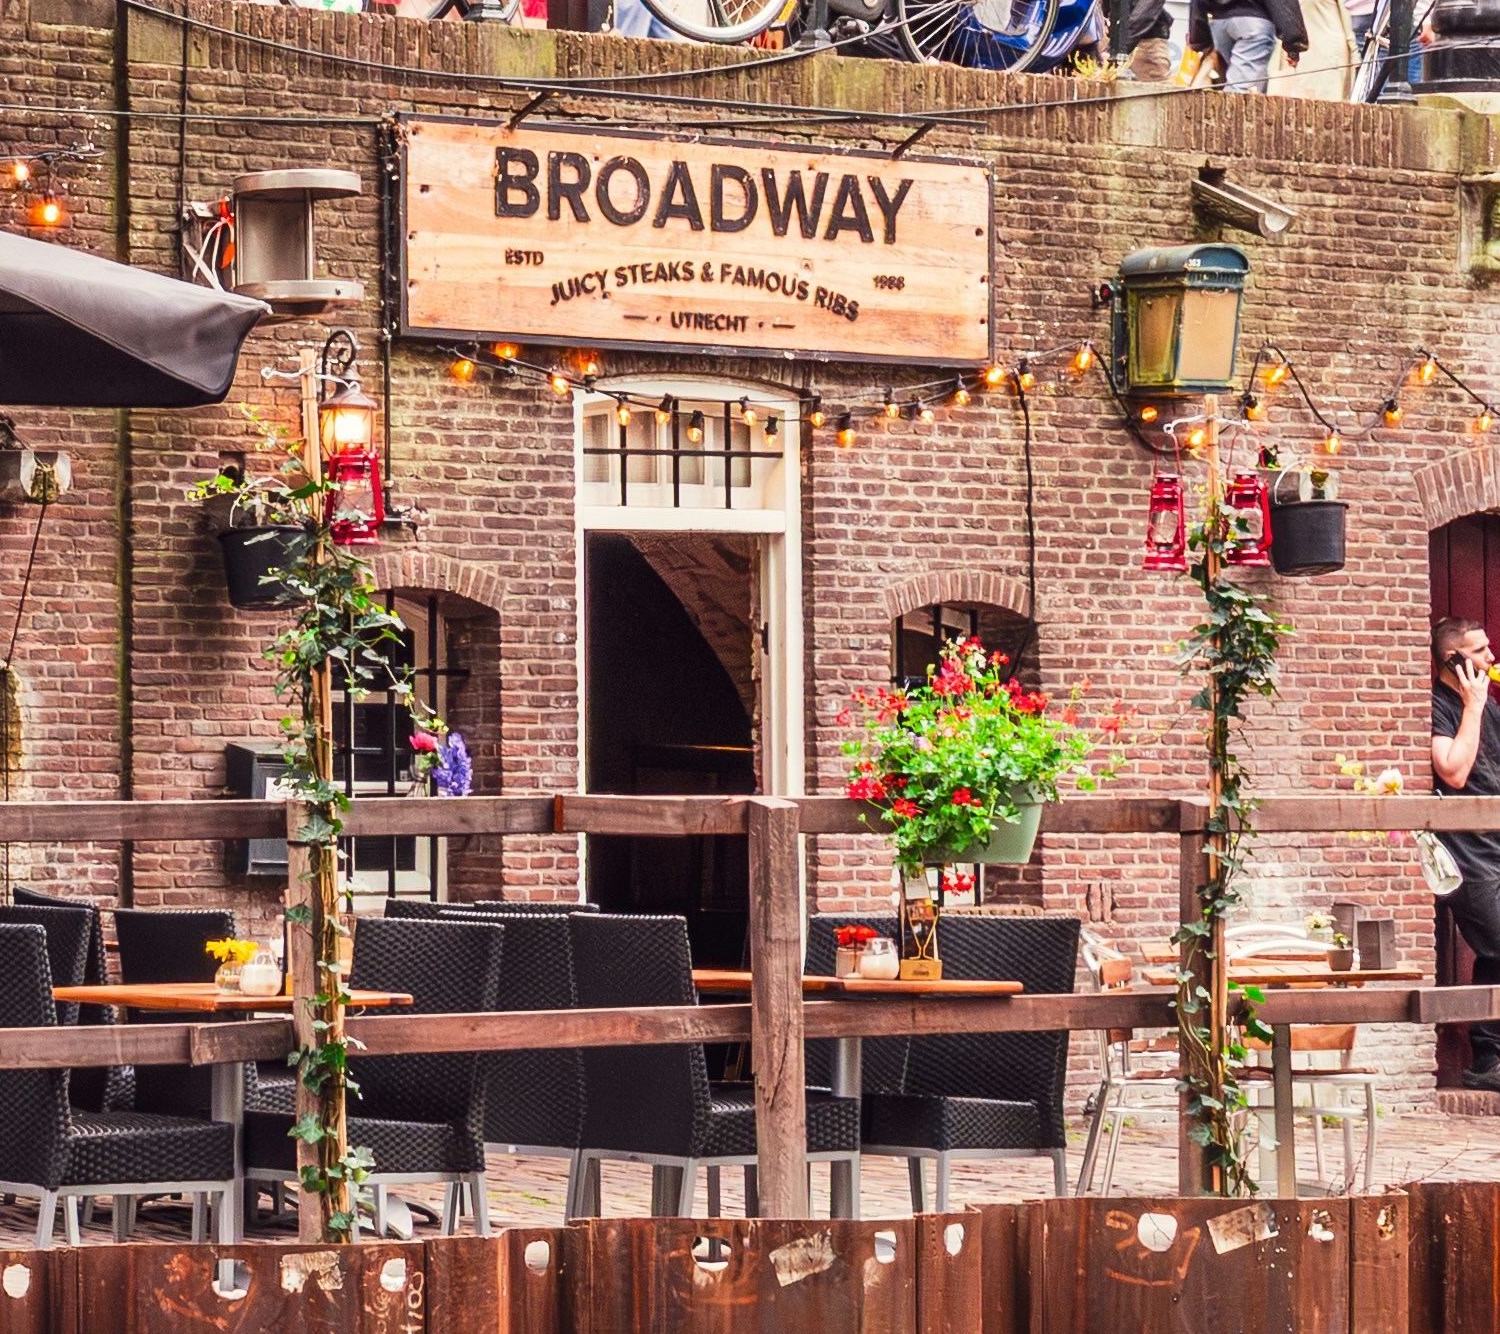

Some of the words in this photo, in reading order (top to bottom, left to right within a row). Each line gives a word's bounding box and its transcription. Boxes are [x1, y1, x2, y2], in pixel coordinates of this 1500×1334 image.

[493, 145, 914, 245] BROADWAY
[504, 247, 545, 267] ESTD
[550, 268, 609, 307] JUICY
[614, 261, 696, 288] STEAKS
[700, 261, 715, 283] &
[720, 263, 810, 301] FAMOUS
[813, 284, 861, 323] RIBS
[670, 310, 749, 333] UTRECHT
